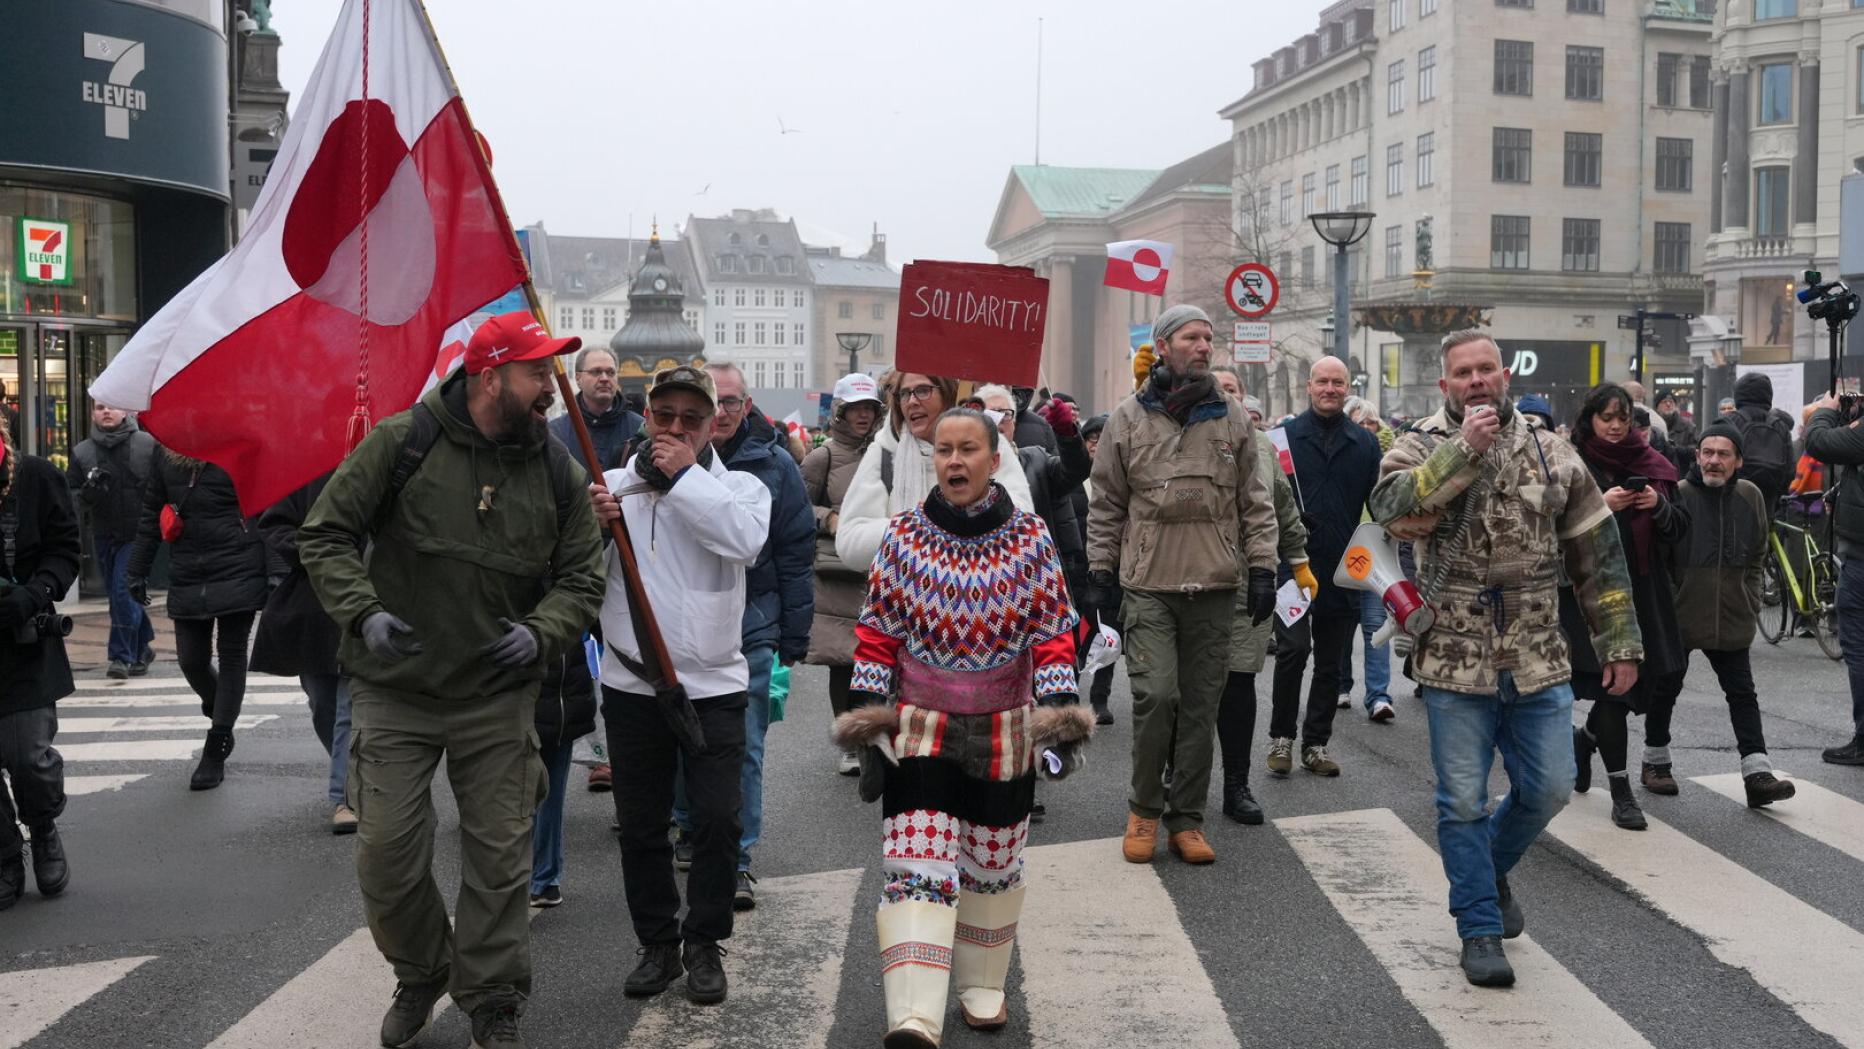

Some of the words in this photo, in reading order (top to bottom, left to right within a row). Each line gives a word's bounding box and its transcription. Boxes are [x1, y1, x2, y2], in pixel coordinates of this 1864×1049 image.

[83, 31, 146, 140] 7
[30, 227, 61, 280] 7
[909, 286, 1041, 332] SOLIDARITY!
